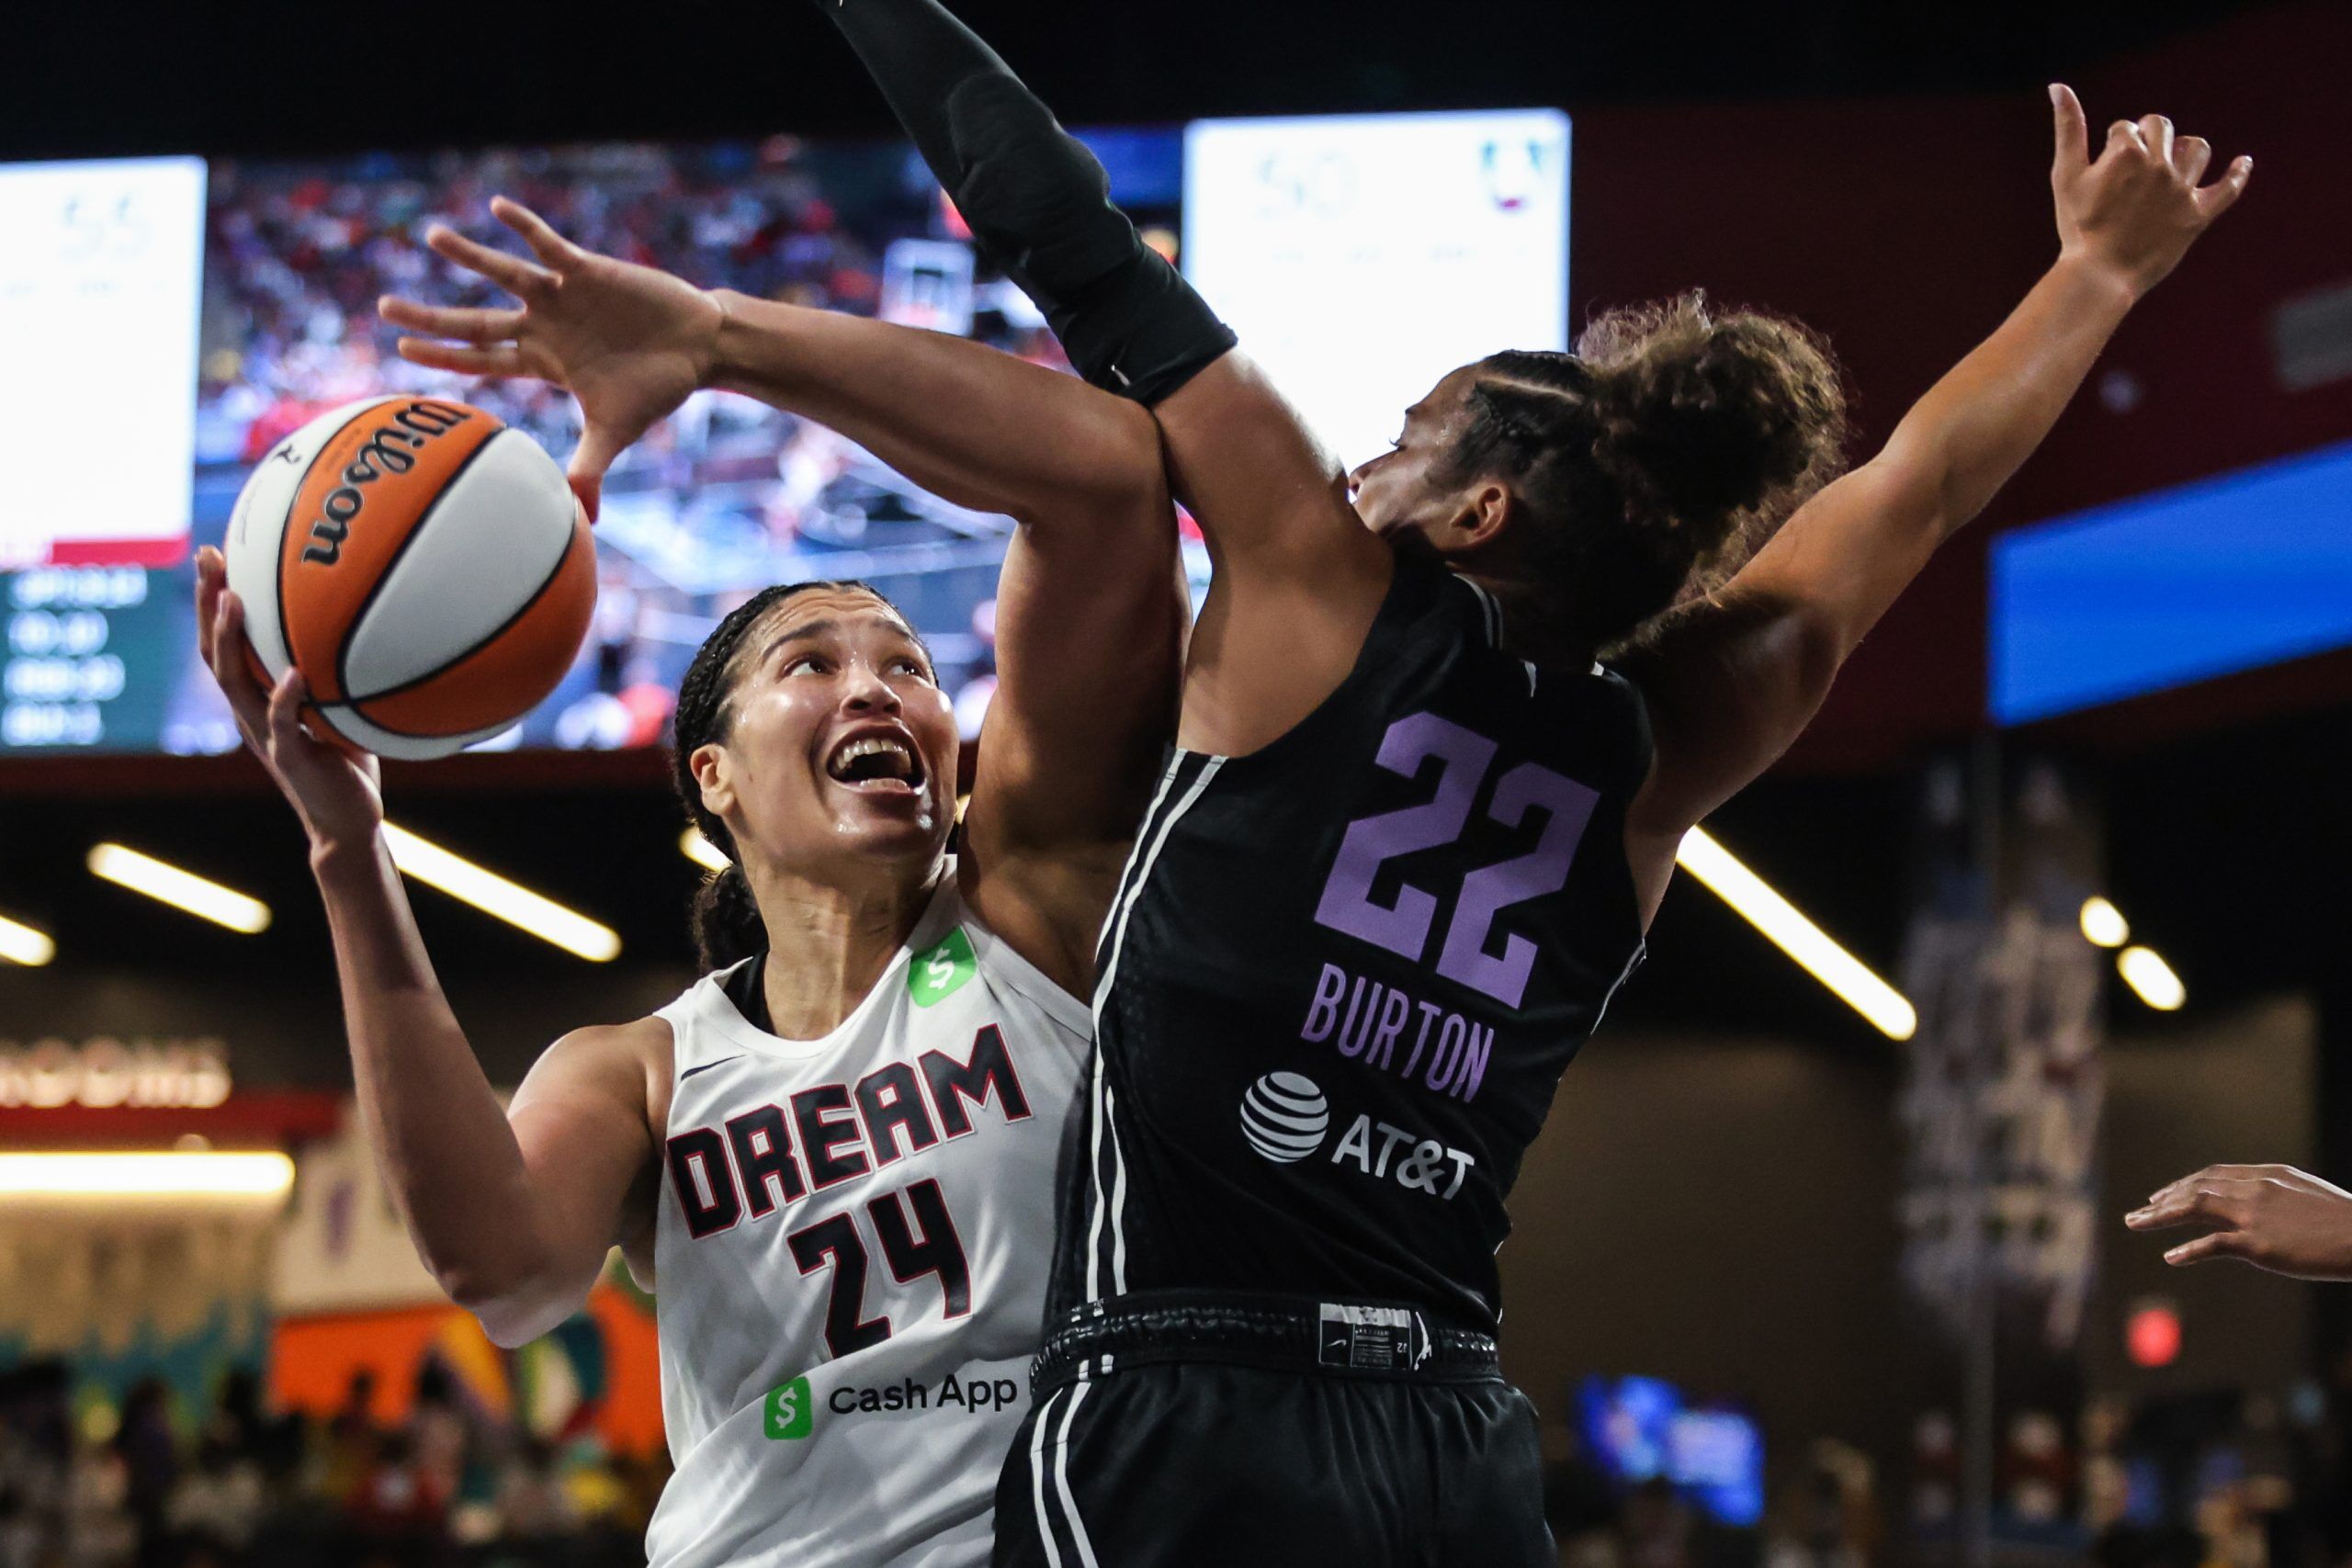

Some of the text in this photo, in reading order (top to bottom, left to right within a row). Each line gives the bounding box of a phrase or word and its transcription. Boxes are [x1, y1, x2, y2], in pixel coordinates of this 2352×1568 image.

[301, 402, 472, 566] Wilson
[1314, 711, 1601, 1010] 22
[1300, 962, 1495, 1104] BURTON
[666, 1022, 1032, 1239] DREAM
[1330, 1112, 1476, 1201] AT&T
[786, 1178, 973, 1360] 24
[829, 1378, 927, 1415] Cash
[936, 1373, 1017, 1414] App
